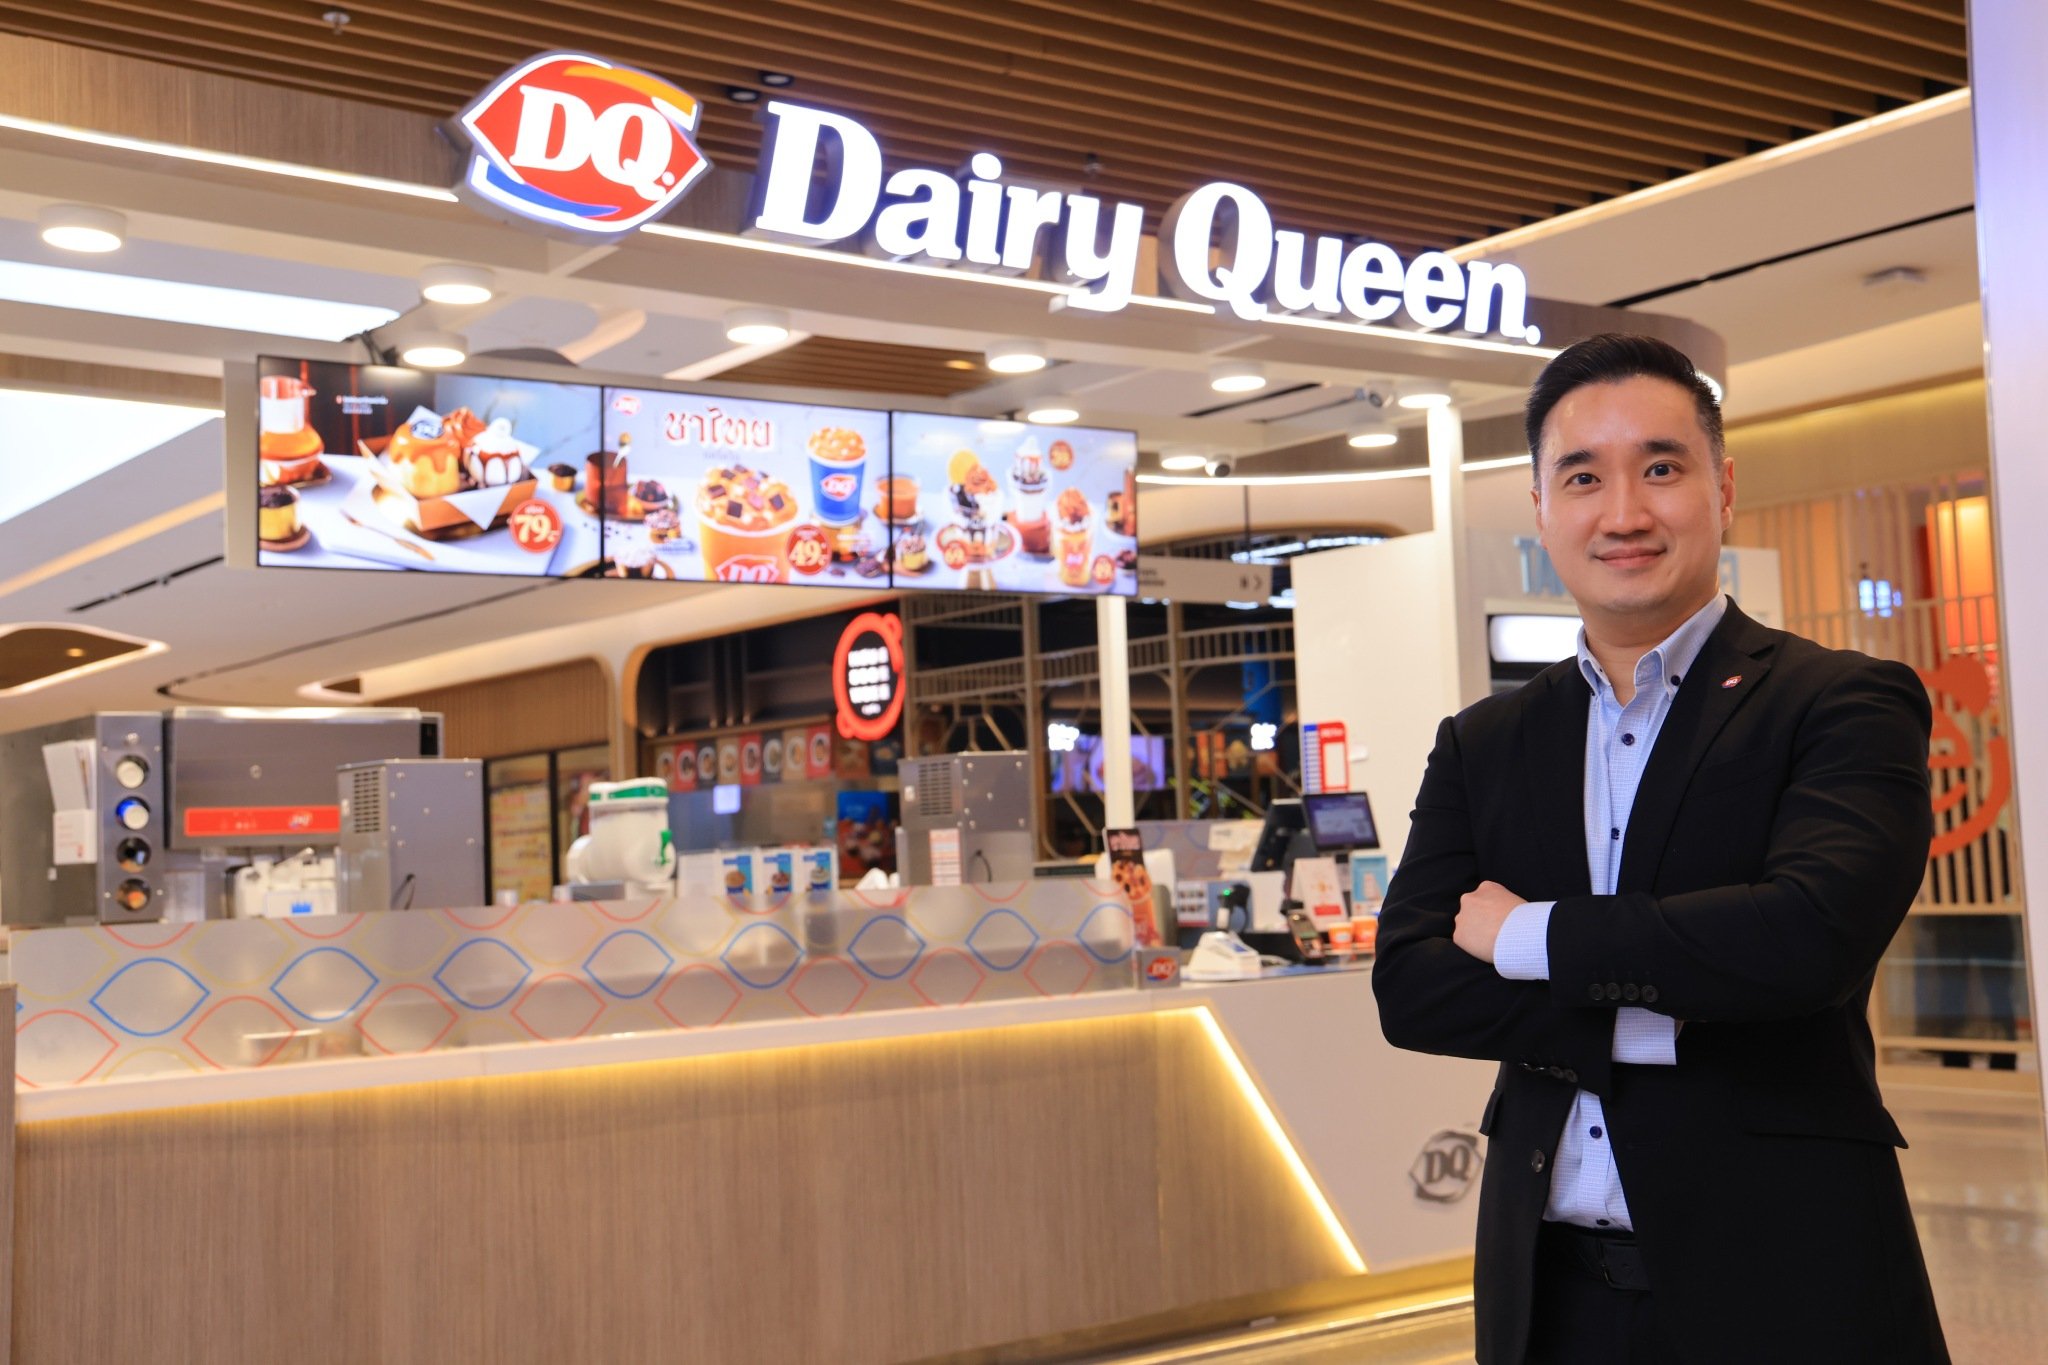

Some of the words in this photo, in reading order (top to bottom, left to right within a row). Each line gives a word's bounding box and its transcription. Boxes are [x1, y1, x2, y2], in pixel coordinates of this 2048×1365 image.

[756, 101, 1144, 312] Dairy
[1174, 182, 1541, 345] Queen.
[664, 406, 772, 447] ชาไทย
[1423, 1144, 1470, 1185] DQ
